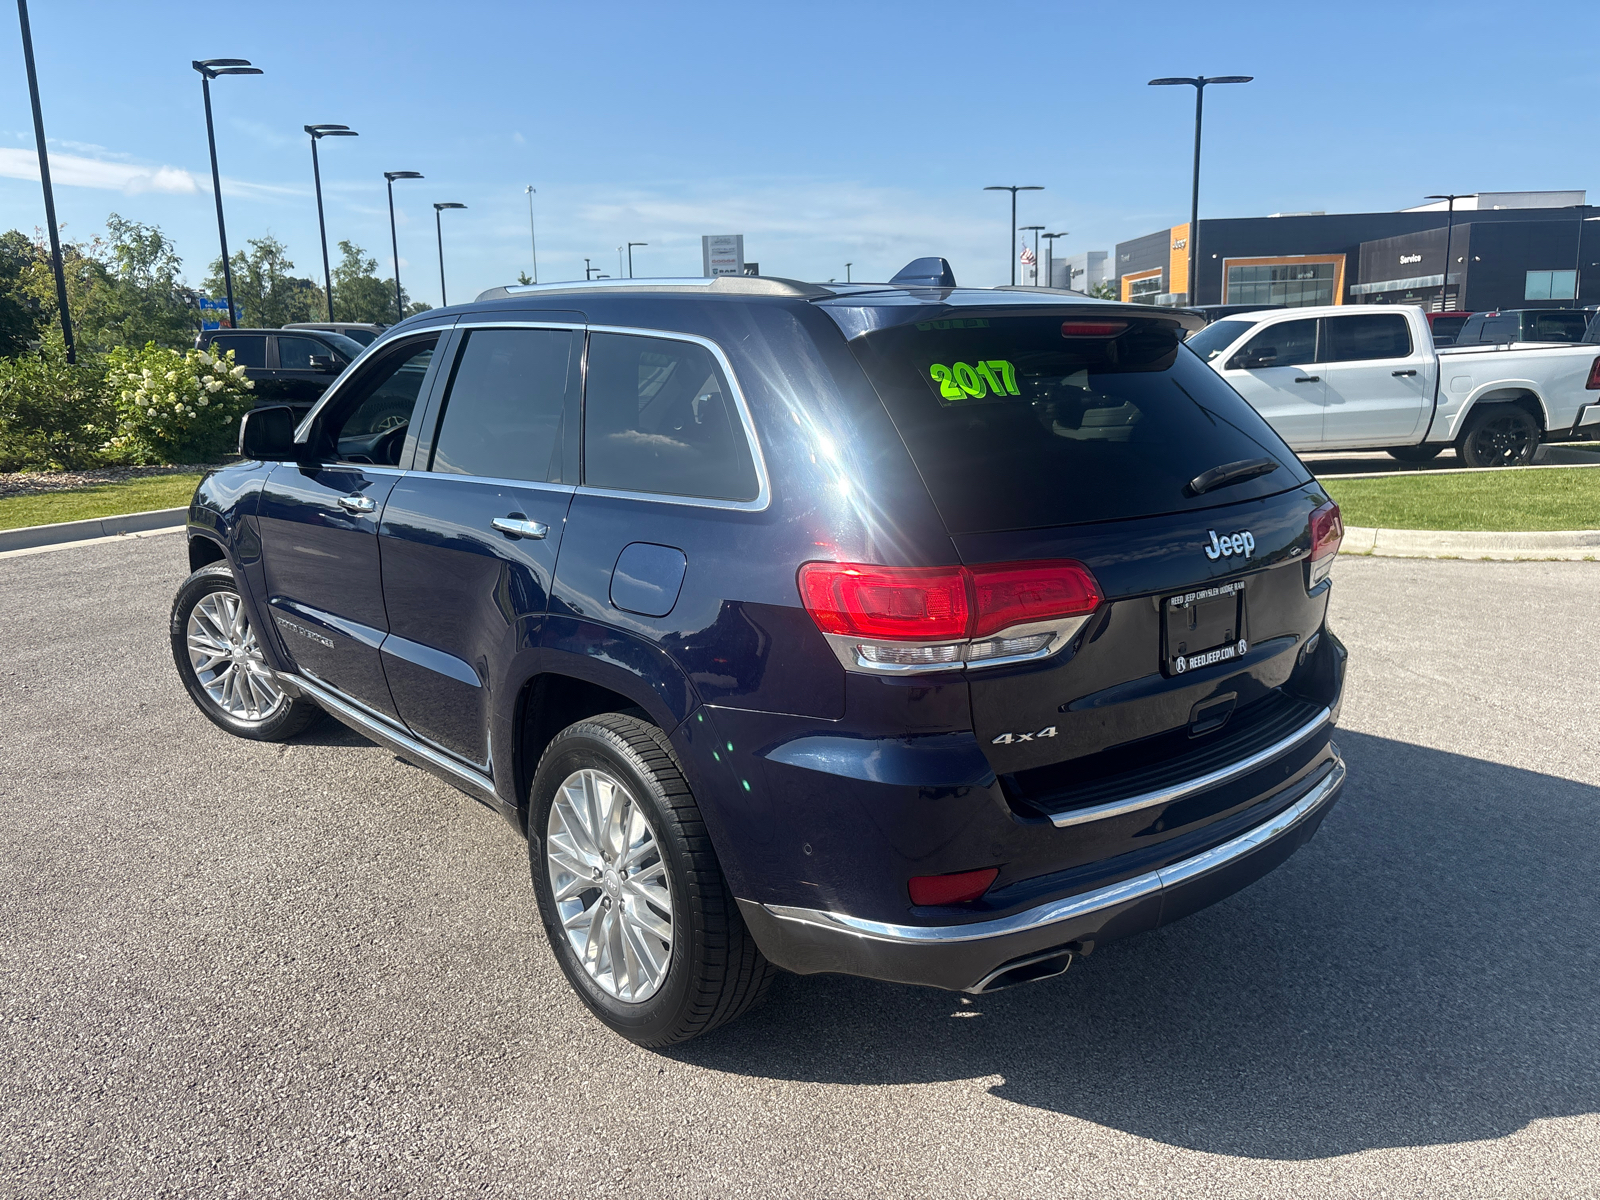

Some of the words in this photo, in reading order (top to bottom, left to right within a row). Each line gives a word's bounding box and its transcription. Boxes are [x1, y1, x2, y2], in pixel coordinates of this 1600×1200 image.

[1400, 253, 1422, 265] Service
[930, 360, 1020, 400] 2017
[1204, 529, 1255, 560] Jeep
[1171, 596, 1184, 606] REED
[1184, 592, 1196, 604] JEEP
[1197, 588, 1219, 599] CHRYSLER
[1189, 646, 1234, 669] REEDJEEP.COM
[991, 726, 1059, 745] 4x4
